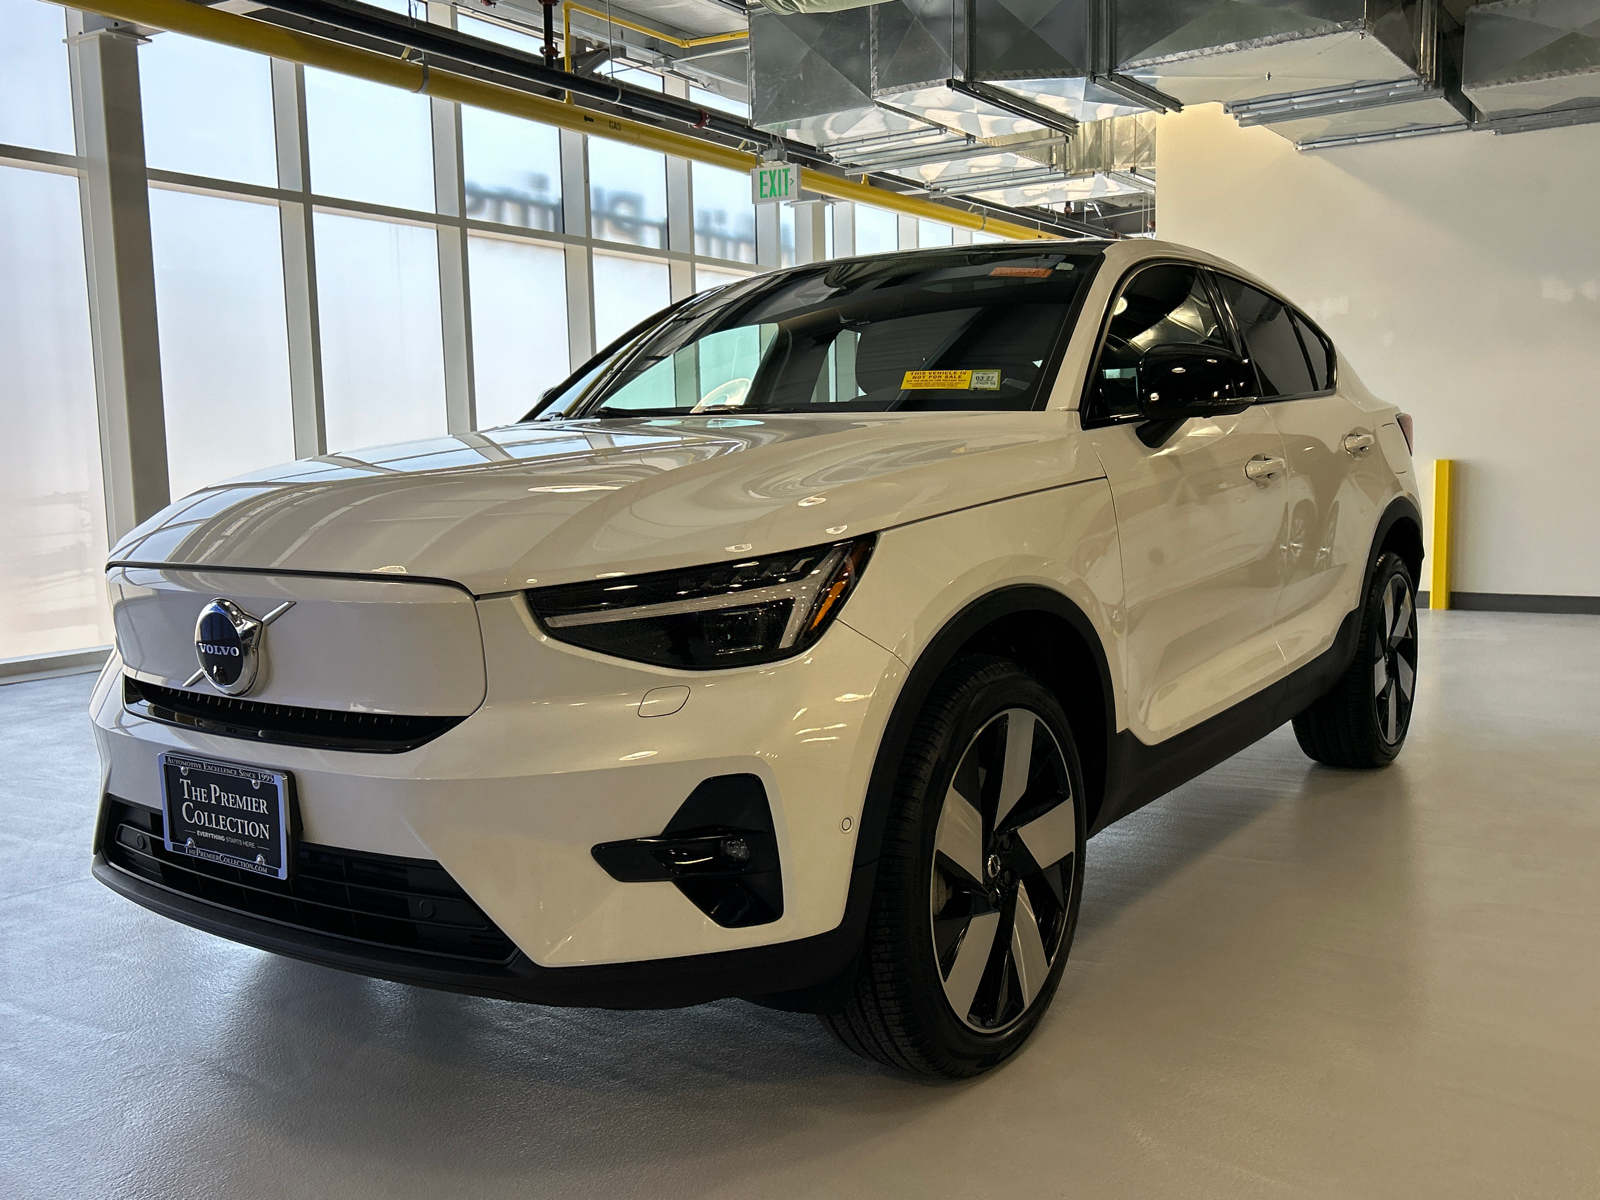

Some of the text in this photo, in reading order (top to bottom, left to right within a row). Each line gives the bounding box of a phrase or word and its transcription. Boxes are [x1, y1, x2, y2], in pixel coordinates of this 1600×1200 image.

[608, 120, 622, 131] GAS
[759, 168, 790, 198] EXIT
[198, 643, 240, 657] VOLVO
[239, 769, 256, 779] SINCE
[257, 774, 274, 783] 1995
[180, 778, 269, 815] THE PREMIER
[182, 801, 270, 840] COLLECTION
[196, 830, 226, 842] EVERYTHING
[225, 837, 242, 846] STARTS
